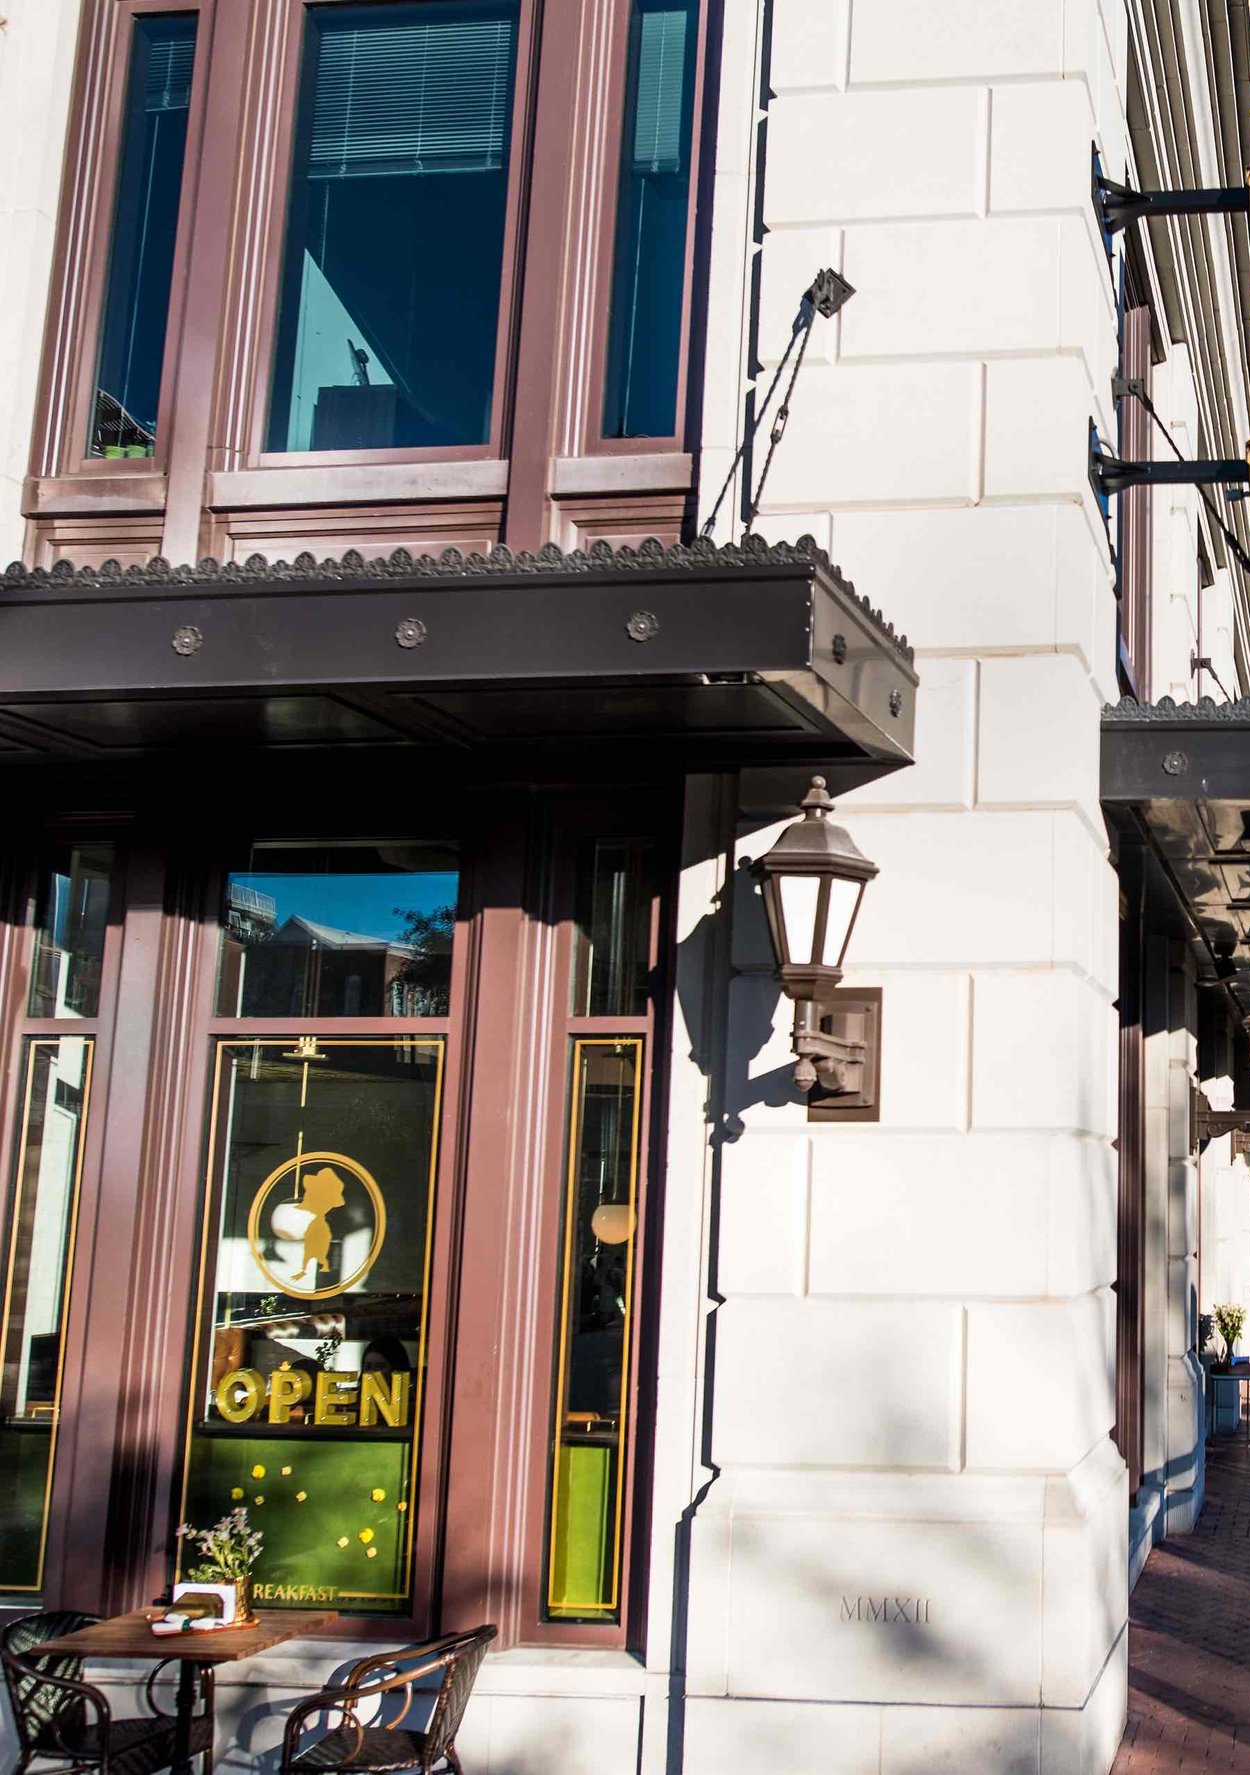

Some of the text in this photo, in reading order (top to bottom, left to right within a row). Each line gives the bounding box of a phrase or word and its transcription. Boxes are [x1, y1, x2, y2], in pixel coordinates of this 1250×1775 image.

[216, 1369, 410, 1427] OPEN
[252, 1583, 338, 1602] REAKFAST
[840, 1596, 930, 1623] MMXII
